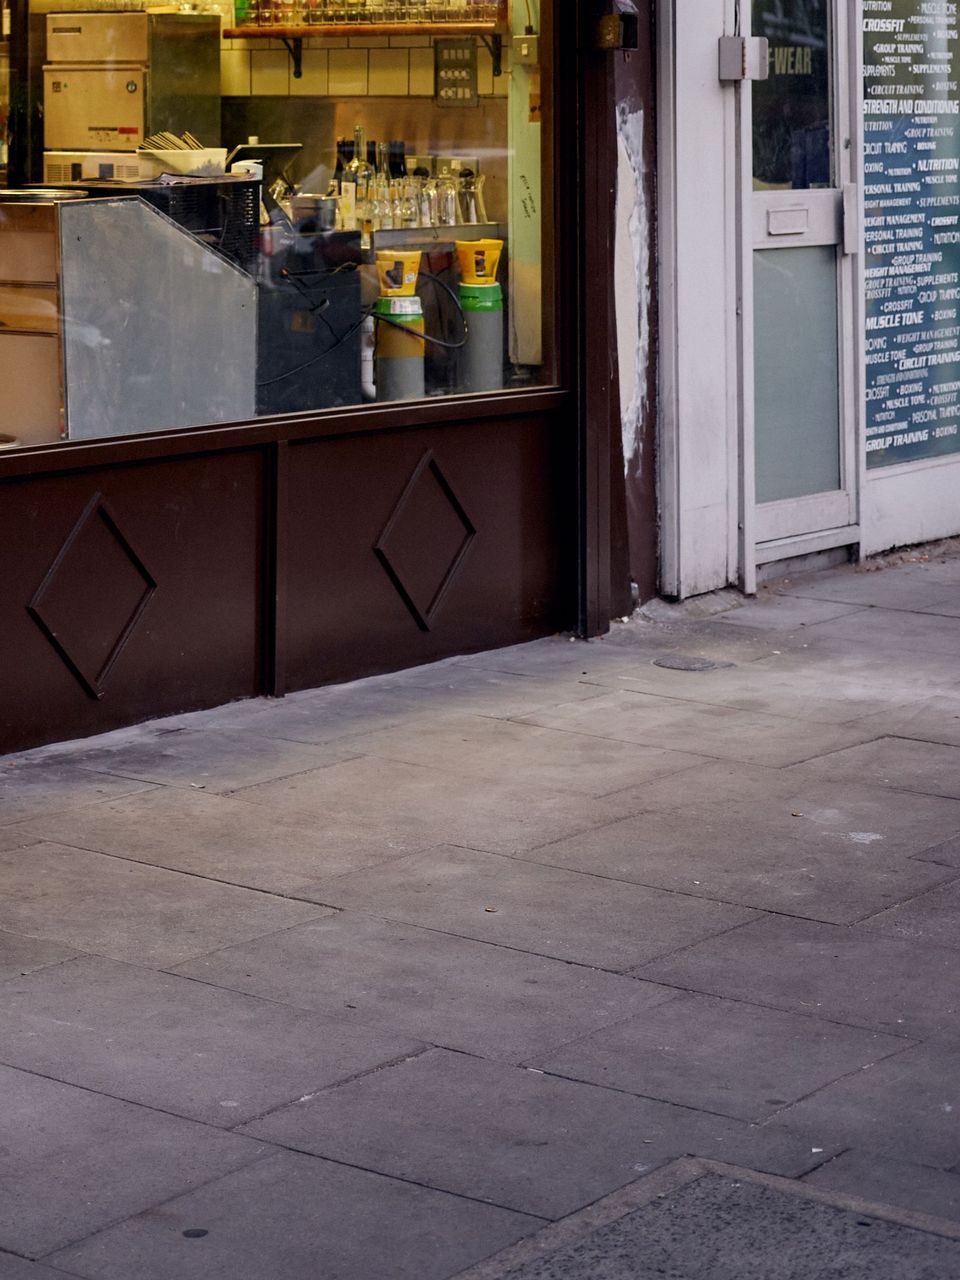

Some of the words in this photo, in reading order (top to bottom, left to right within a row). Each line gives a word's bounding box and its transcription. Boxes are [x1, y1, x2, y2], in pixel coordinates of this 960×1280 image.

[863, 18, 905, 32] CROSSFIT
[913, 64, 951, 74] SUPPLEMENTS
[863, 99, 897, 114] STRENGTH
[914, 100, 959, 114] CONDITIONING
[864, 121, 893, 131] UTRITION
[864, 162, 884, 173] OXING
[917, 158, 959, 171] NUTRITION
[864, 200, 879, 209] EIGHT
[917, 273, 958, 286] SUPPLEMENTS
[884, 299, 913, 312] CROSSFIT
[865, 314, 901, 330] MUSCLE
[902, 311, 924, 326] TONE
[866, 435, 893, 452] GROUP
[893, 429, 929, 446] TRAINING
